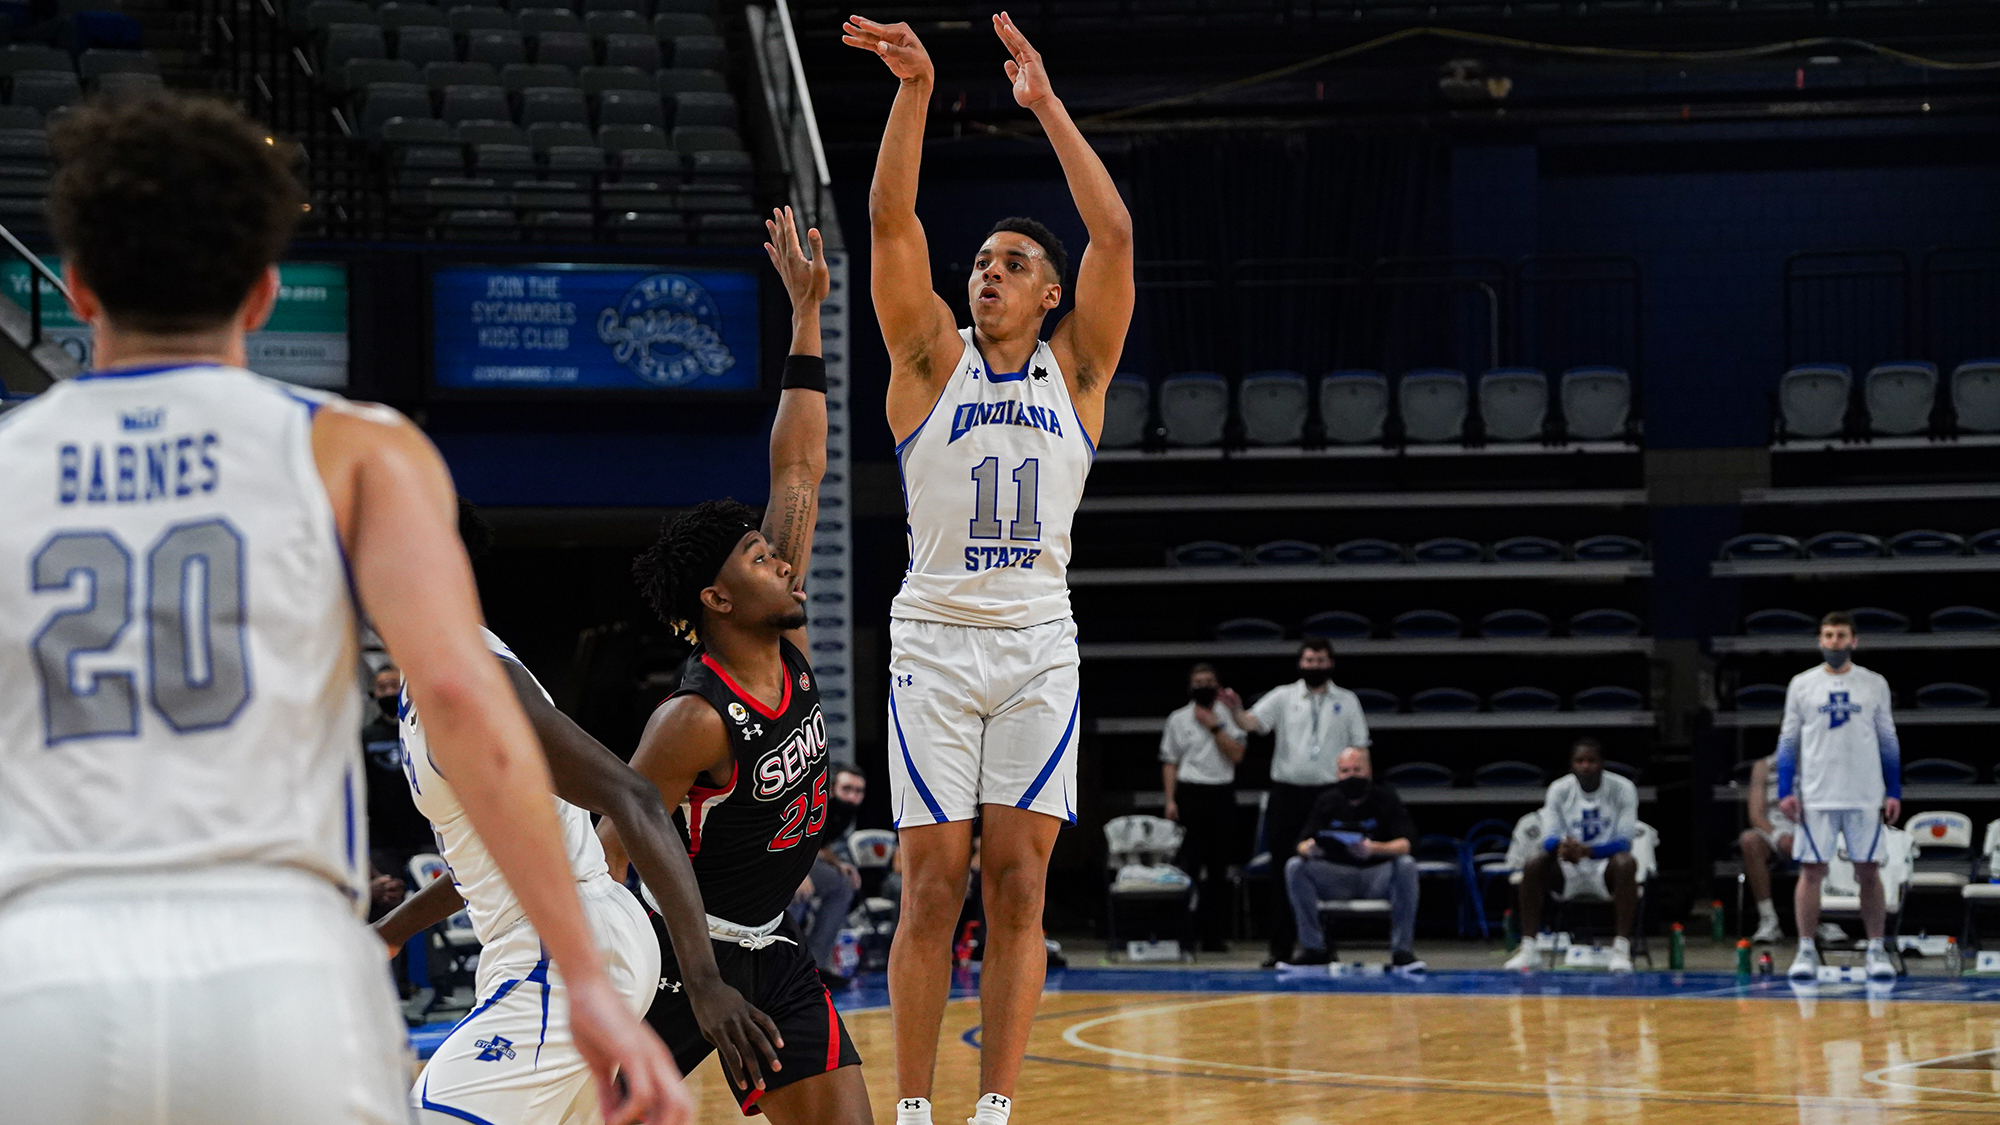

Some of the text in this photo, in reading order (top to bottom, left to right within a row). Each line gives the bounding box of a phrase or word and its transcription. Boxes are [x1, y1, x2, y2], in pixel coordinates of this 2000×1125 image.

[471, 301, 577, 325] SYCAMORES
[486, 275, 562, 299] JOIN THE
[478, 326, 570, 350] KIDS CLUB
[947, 400, 1064, 446] INDIANA
[58, 434, 219, 504] BARNES
[969, 456, 1042, 541] 11
[964, 546, 1042, 572] STATE
[30, 514, 254, 747] 20
[753, 703, 828, 801] SEMO
[767, 766, 828, 852] 25
